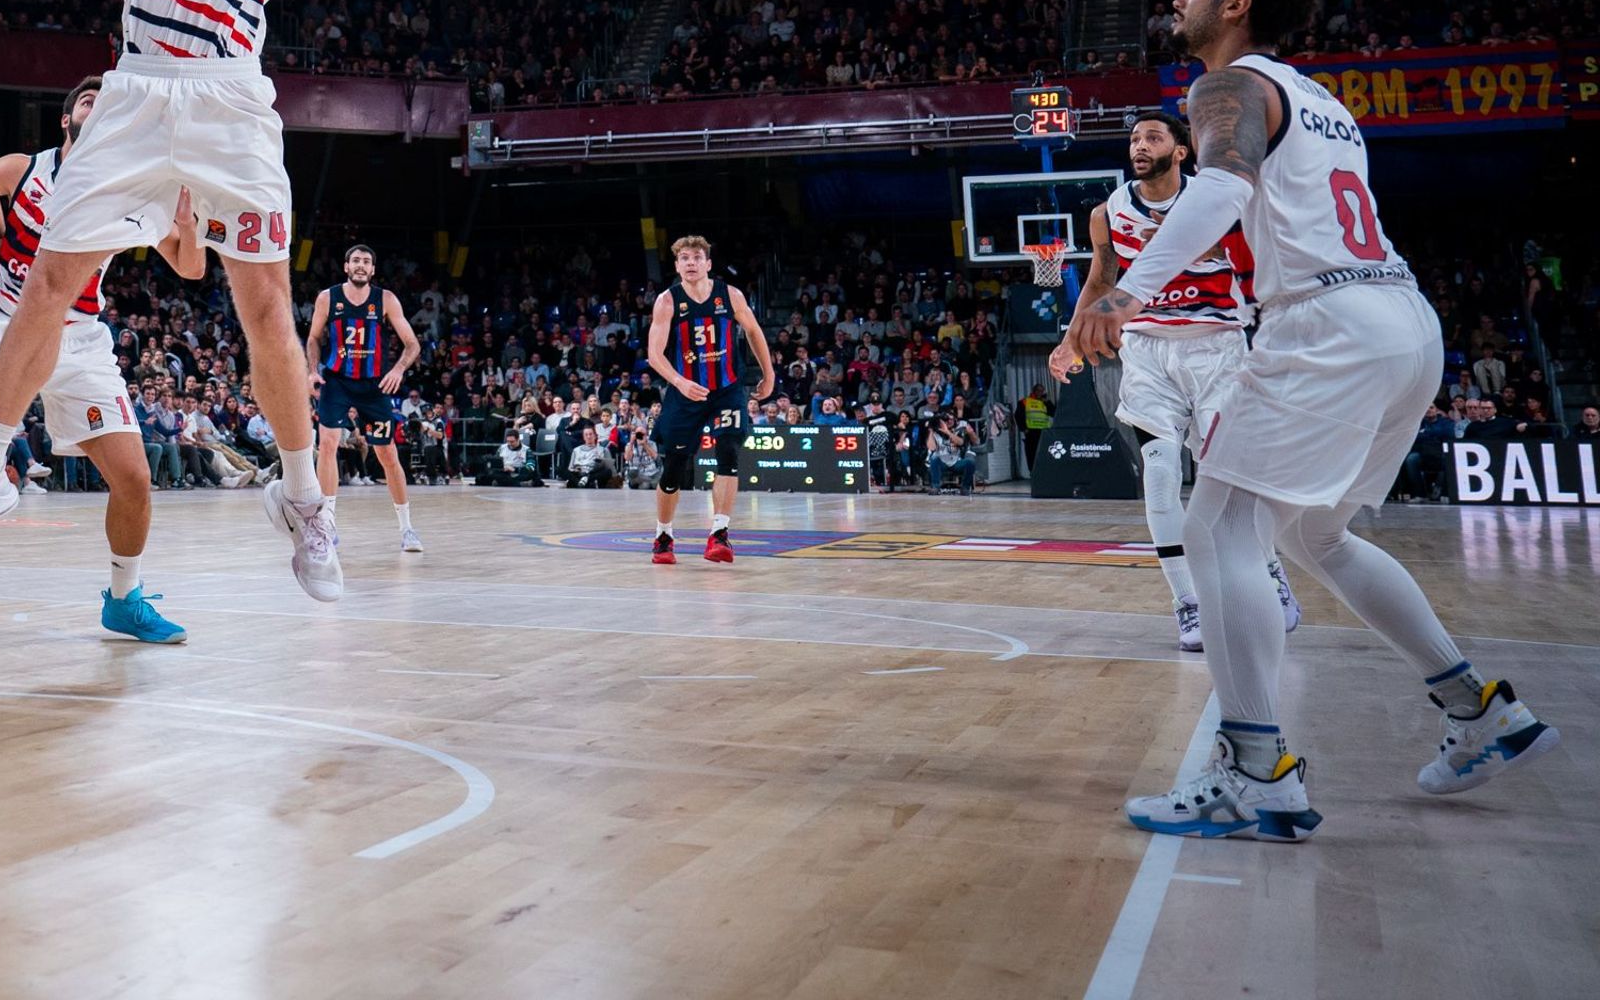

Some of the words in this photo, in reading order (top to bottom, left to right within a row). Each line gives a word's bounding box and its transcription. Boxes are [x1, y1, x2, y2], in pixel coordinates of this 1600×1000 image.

[1445, 62, 1553, 116] 1997
[1035, 110, 1067, 133] 24
[1329, 167, 1387, 262] 0
[237, 210, 287, 254] 24
[344, 325, 365, 345] 21
[694, 323, 716, 346] 31
[373, 419, 391, 439] 21
[720, 409, 741, 429] 31
[743, 435, 784, 451] 4:30
[802, 438, 812, 450] 2
[835, 437, 858, 450] 35
[1069, 442, 1112, 452] Assistència
[705, 471, 715, 482] 3
[844, 473, 854, 485] 5
